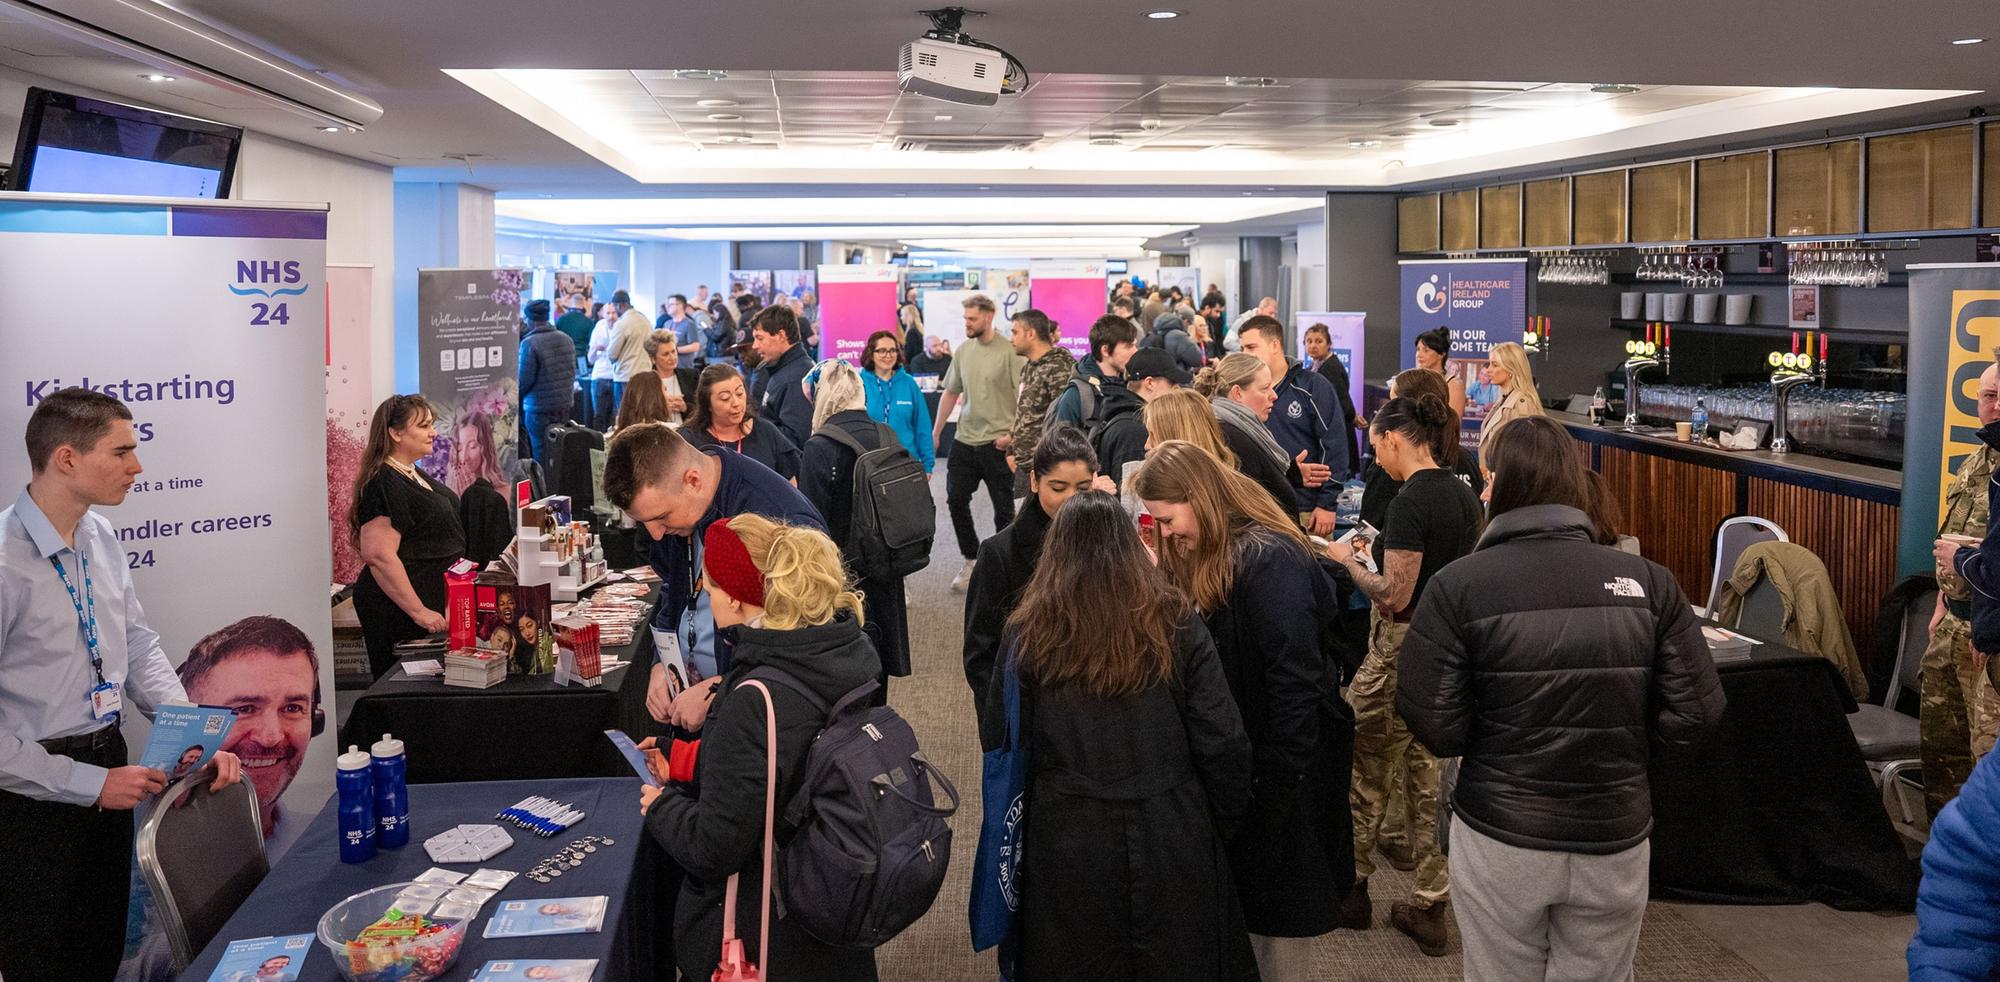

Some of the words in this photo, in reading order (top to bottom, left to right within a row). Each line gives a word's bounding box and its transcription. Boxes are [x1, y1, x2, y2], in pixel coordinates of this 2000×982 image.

[237, 260, 301, 284] NHS
[1452, 280, 1511, 289] HEALTHCARE
[1452, 290, 1490, 298] IRELAND
[1452, 300, 1484, 308] GROUP
[249, 302, 290, 326] 24
[1449, 329, 1460, 340] IN
[1463, 330, 1486, 340] OUR
[836, 339, 865, 349] Shows
[1073, 337, 1090, 346] you
[1450, 341, 1473, 352] OME
[1476, 342, 1499, 352] TEA
[837, 350, 859, 360] can't
[25, 374, 235, 407] Kikstarting
[1460, 431, 1469, 439] UR
[133, 481, 150, 493] at
[154, 482, 164, 492] a
[168, 476, 203, 491] time
[113, 520, 183, 542] ndler
[191, 512, 272, 535] careers
[127, 549, 156, 570] 24
[1614, 576, 1630, 584] THE
[1604, 582, 1630, 591] NORTH
